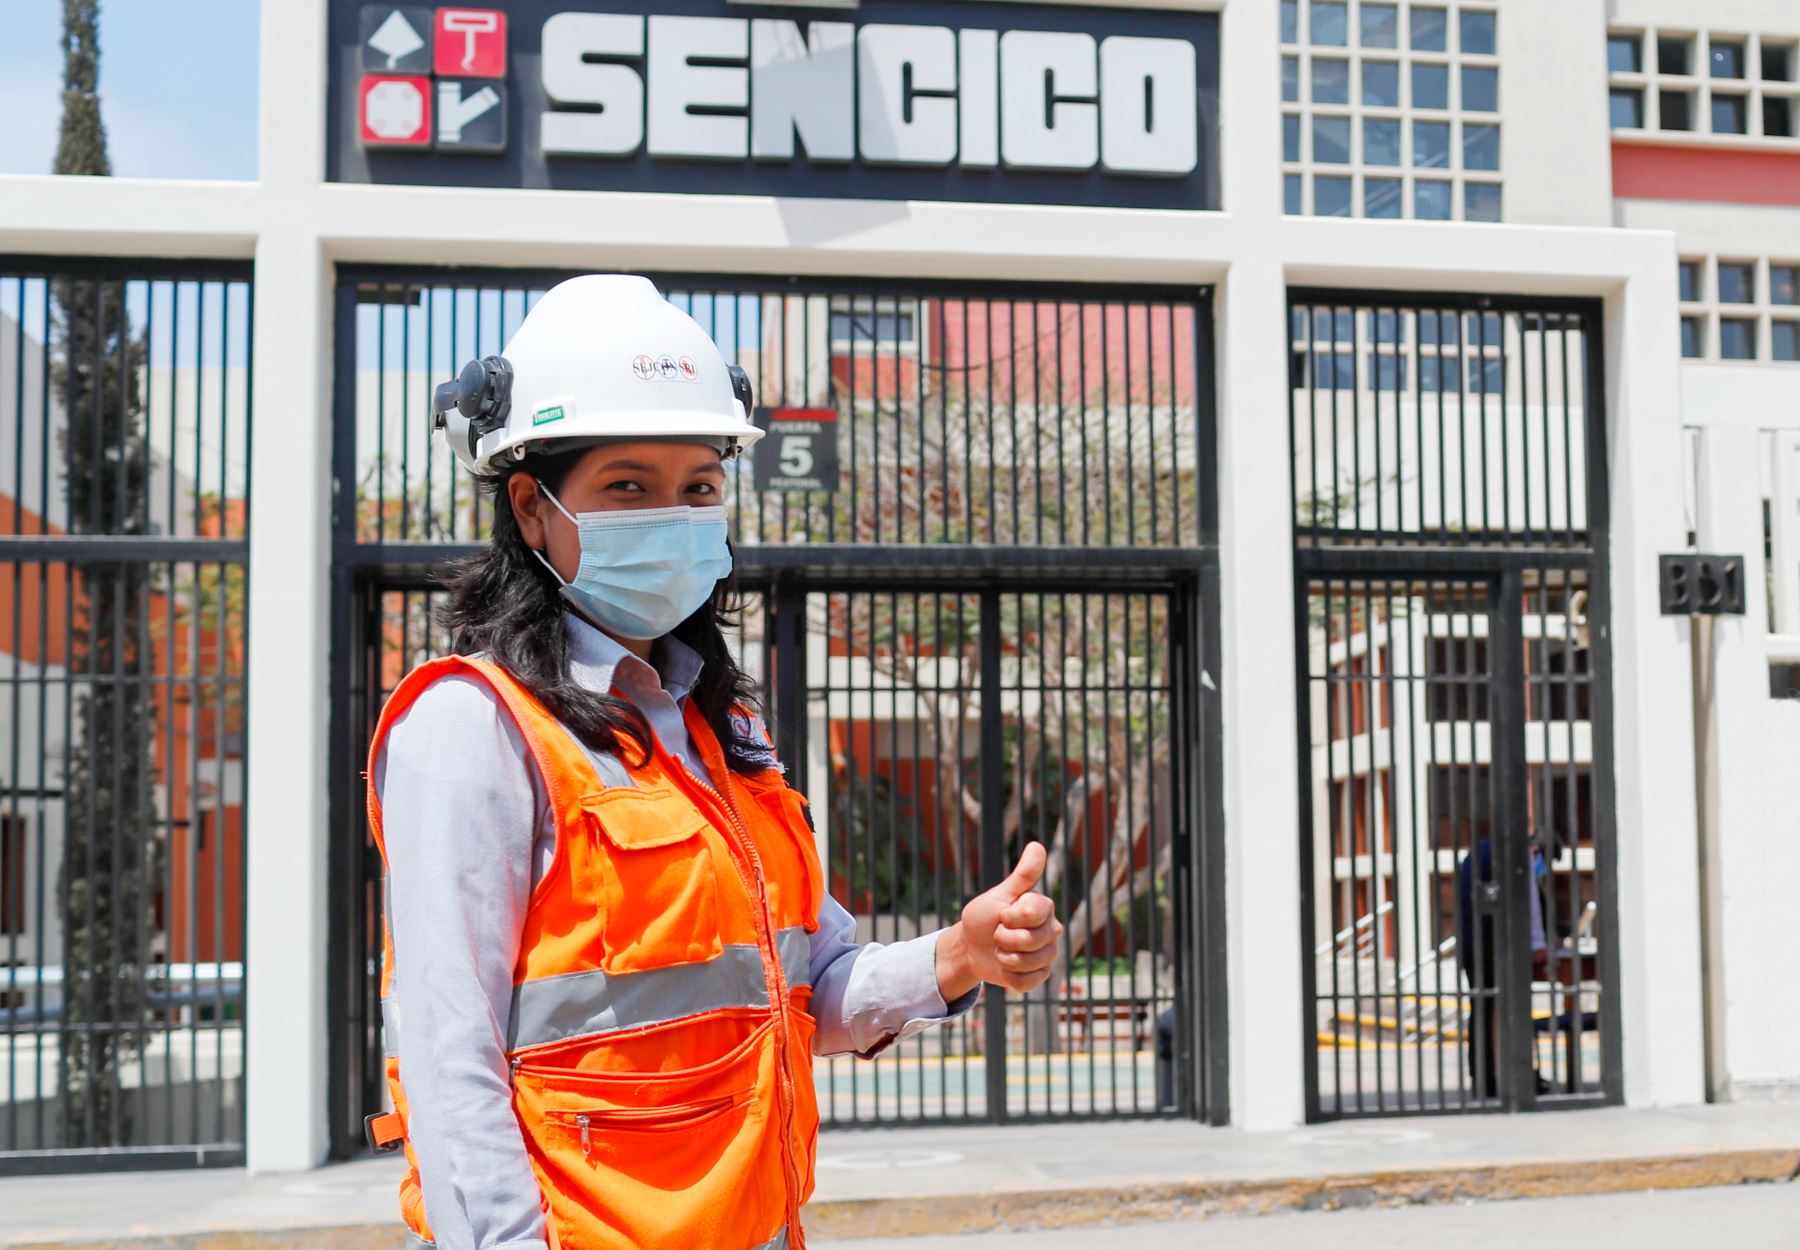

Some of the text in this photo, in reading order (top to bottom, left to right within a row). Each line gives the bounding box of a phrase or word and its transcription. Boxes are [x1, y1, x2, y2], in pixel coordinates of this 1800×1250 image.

[539, 11, 1198, 175] SENCICO
[769, 421, 822, 433] PUERTA
[779, 435, 814, 476] 5
